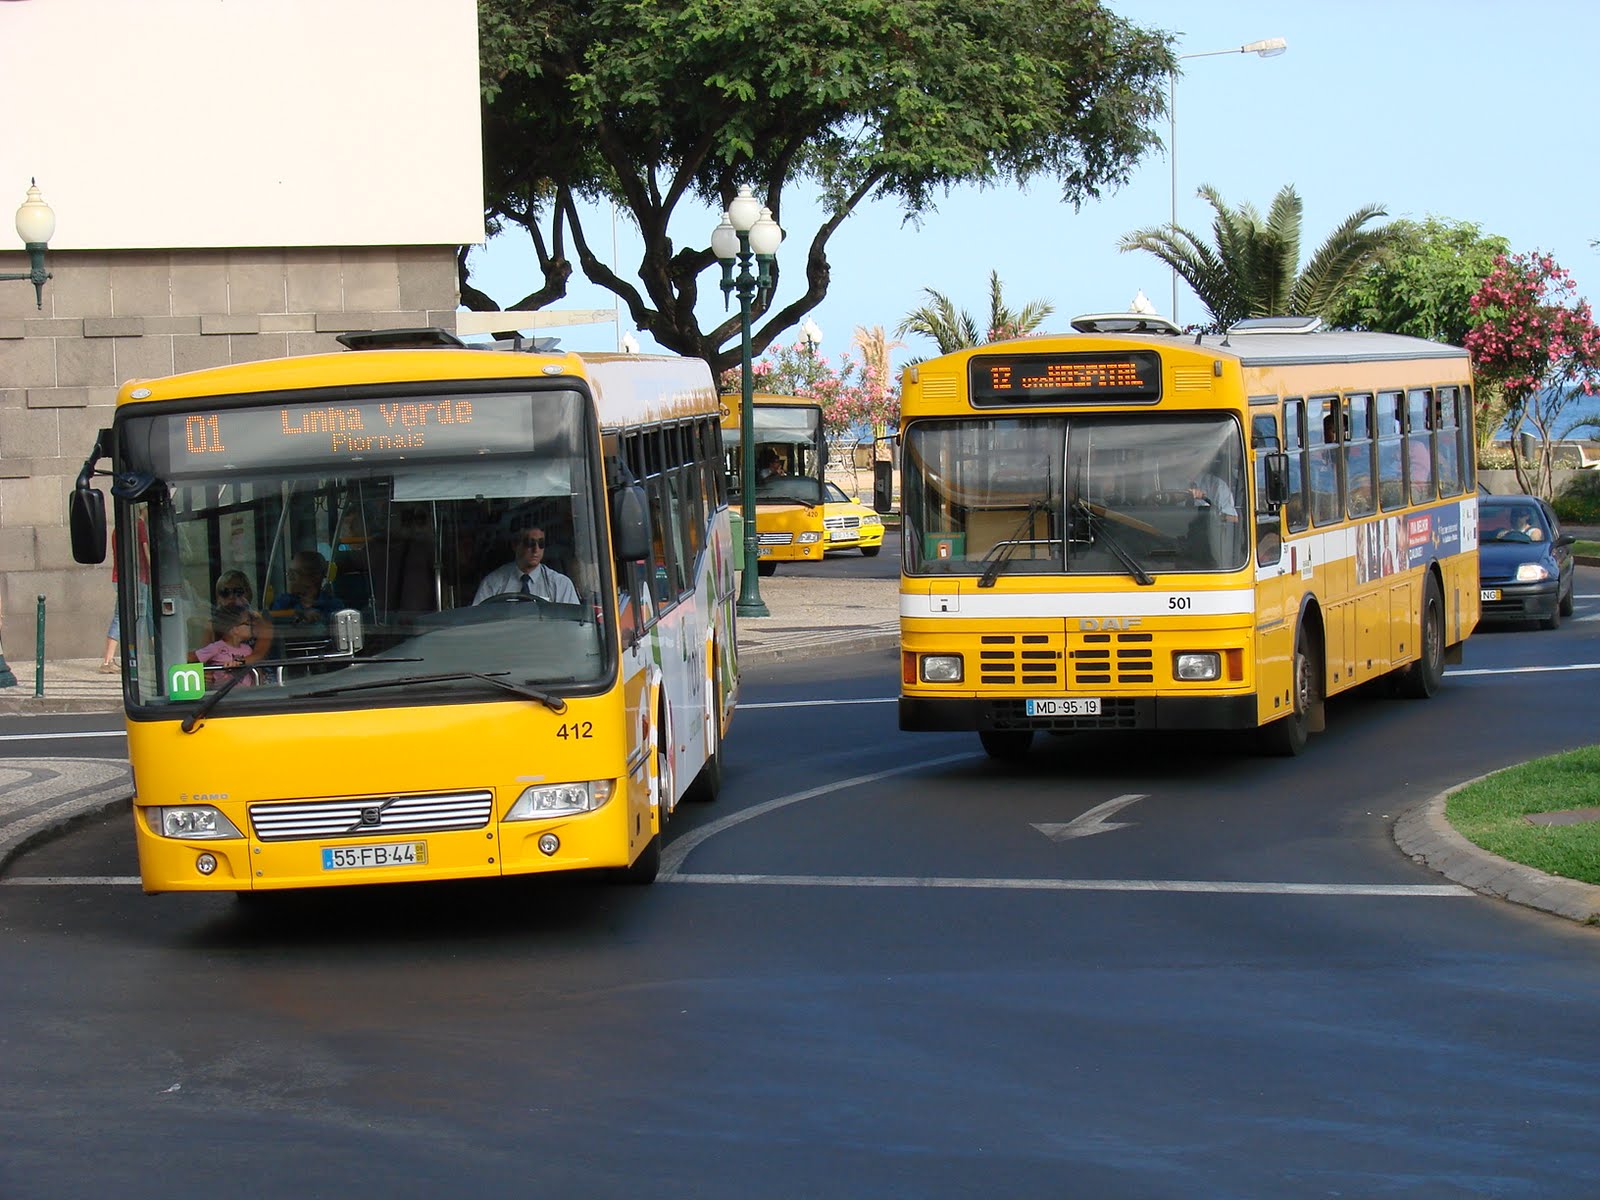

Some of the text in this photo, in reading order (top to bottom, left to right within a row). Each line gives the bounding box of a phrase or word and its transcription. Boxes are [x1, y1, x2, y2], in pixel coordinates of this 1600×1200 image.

[184, 413, 226, 455] 01
[379, 399, 474, 429] Verde
[331, 428, 426, 453] Piornais
[1167, 596, 1192, 610] 501
[1078, 617, 1142, 632] DAF
[172, 670, 201, 692] m
[556, 720, 594, 742] 412
[192, 792, 229, 801] CAMO
